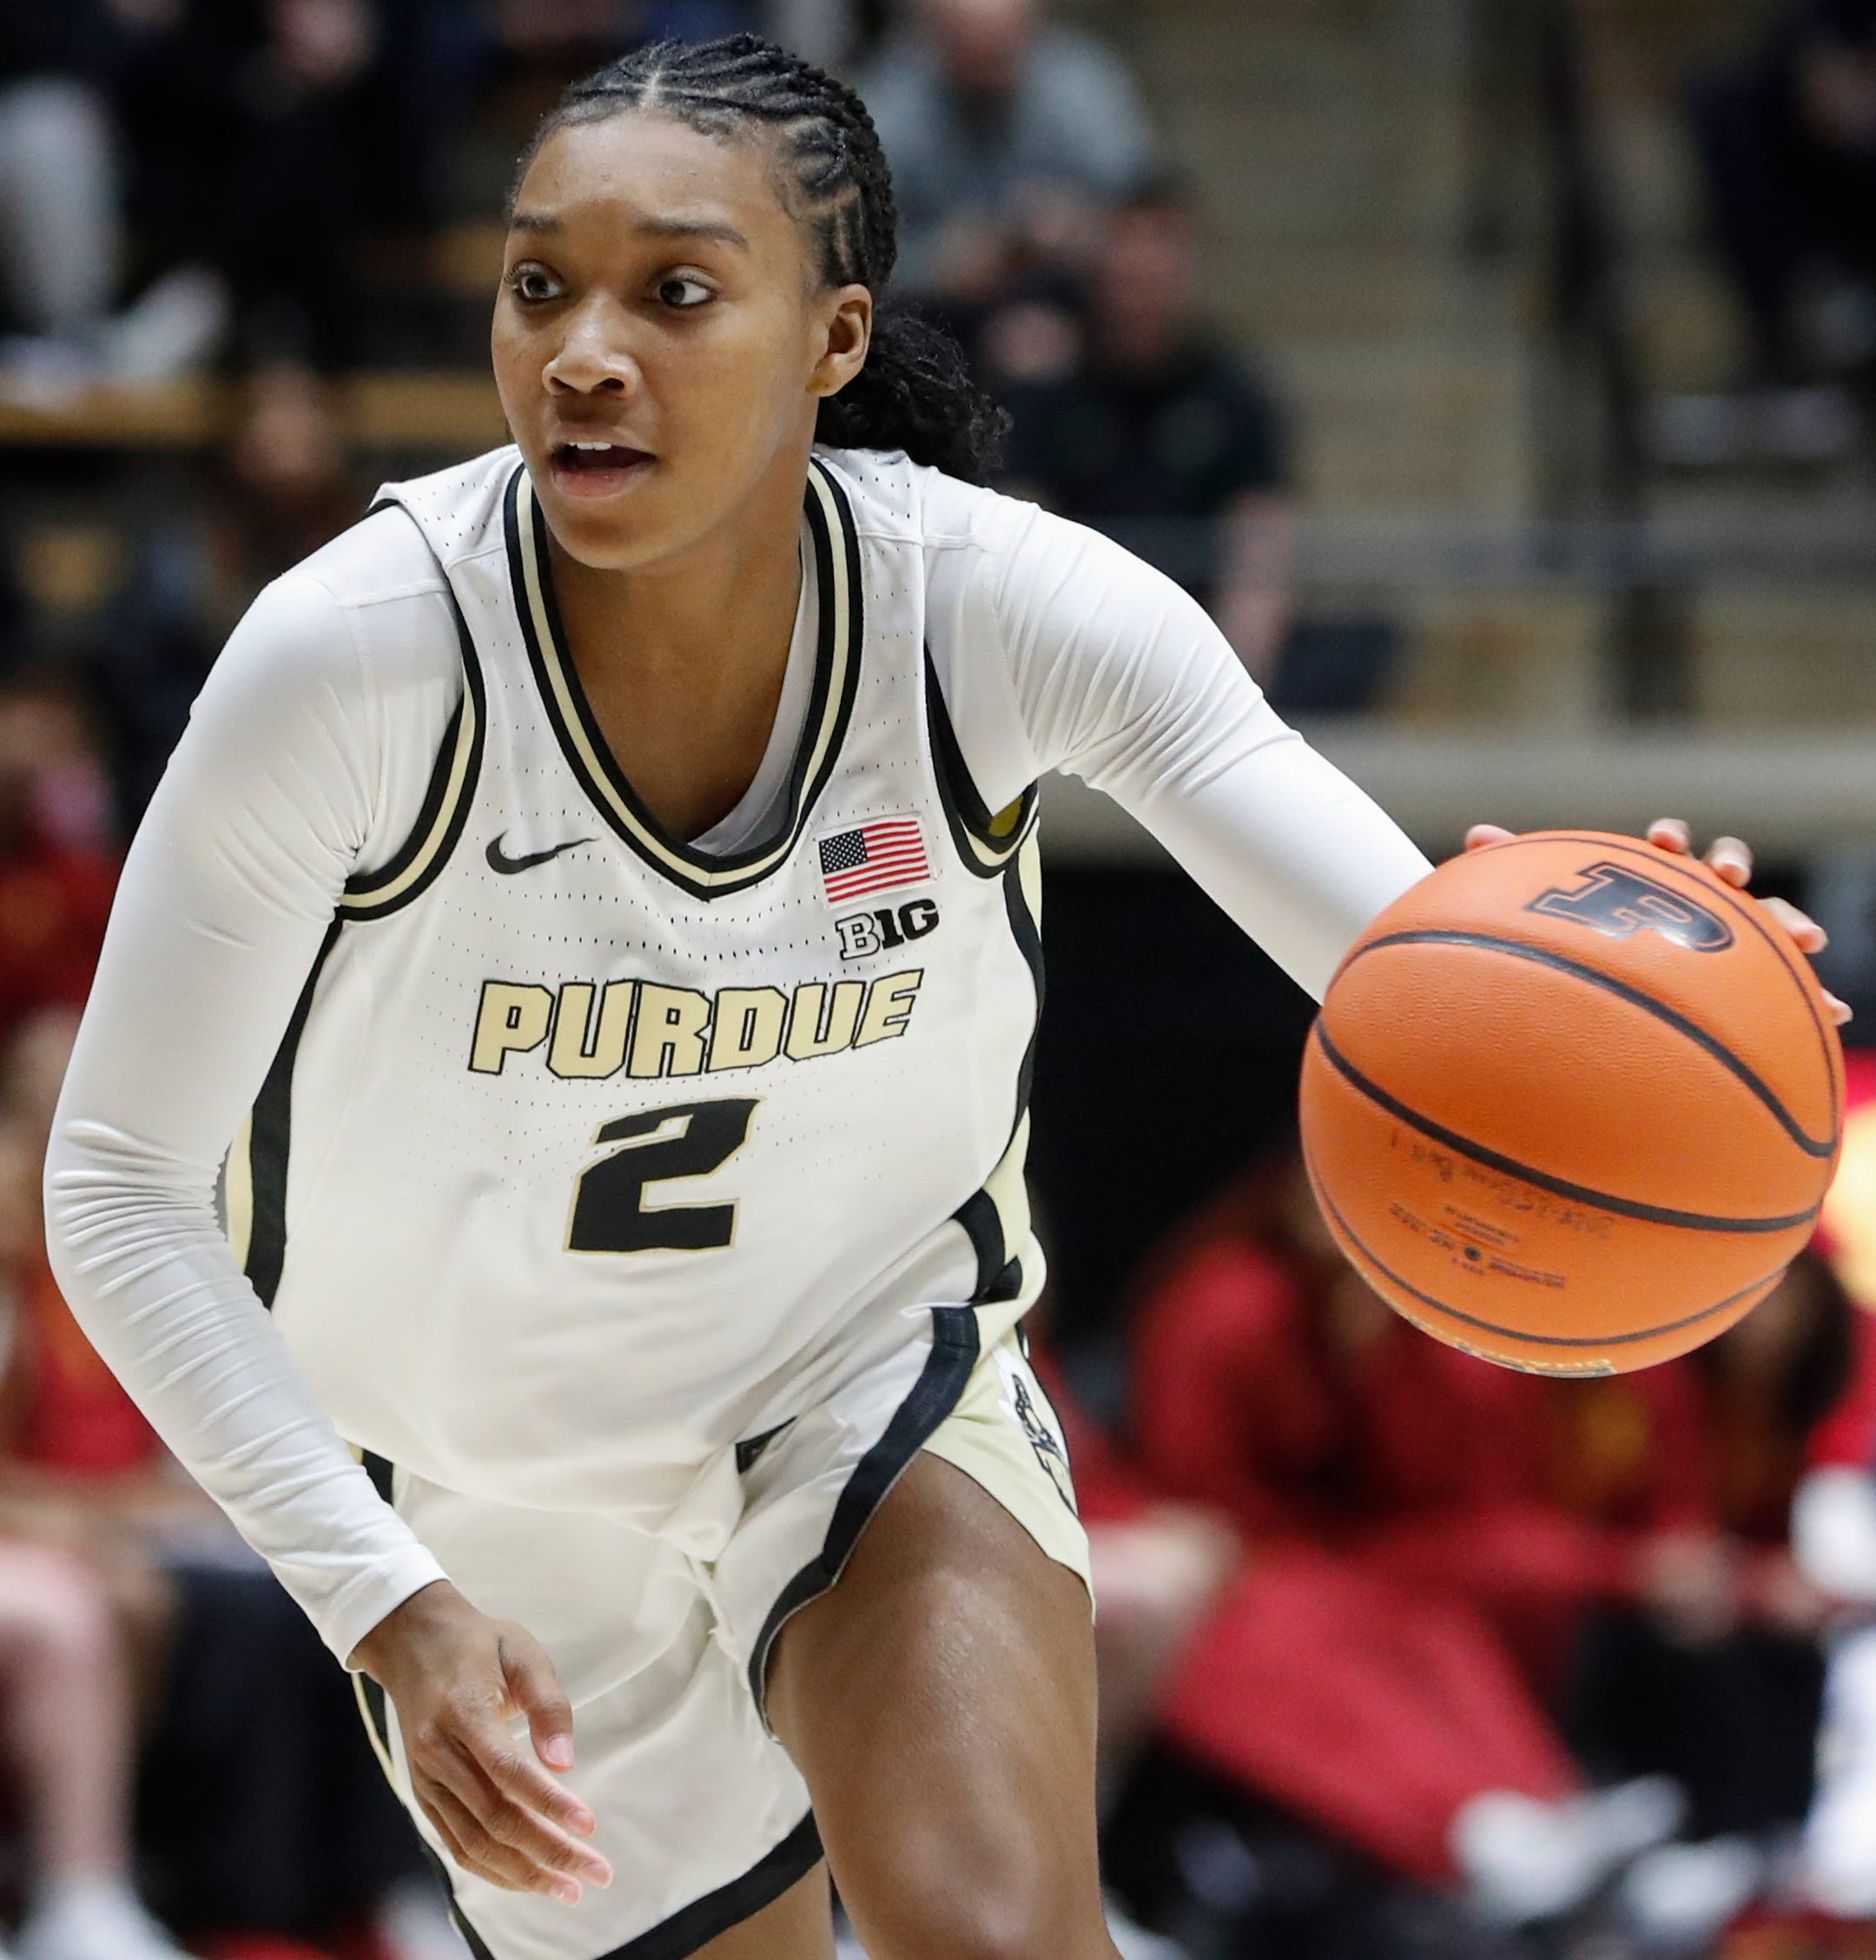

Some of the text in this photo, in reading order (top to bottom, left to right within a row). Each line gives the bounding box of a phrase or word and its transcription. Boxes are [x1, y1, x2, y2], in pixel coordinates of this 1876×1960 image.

[1525, 861, 1734, 953] P
[468, 968, 924, 1079] PURDUE
[564, 1096, 763, 1255] 2
